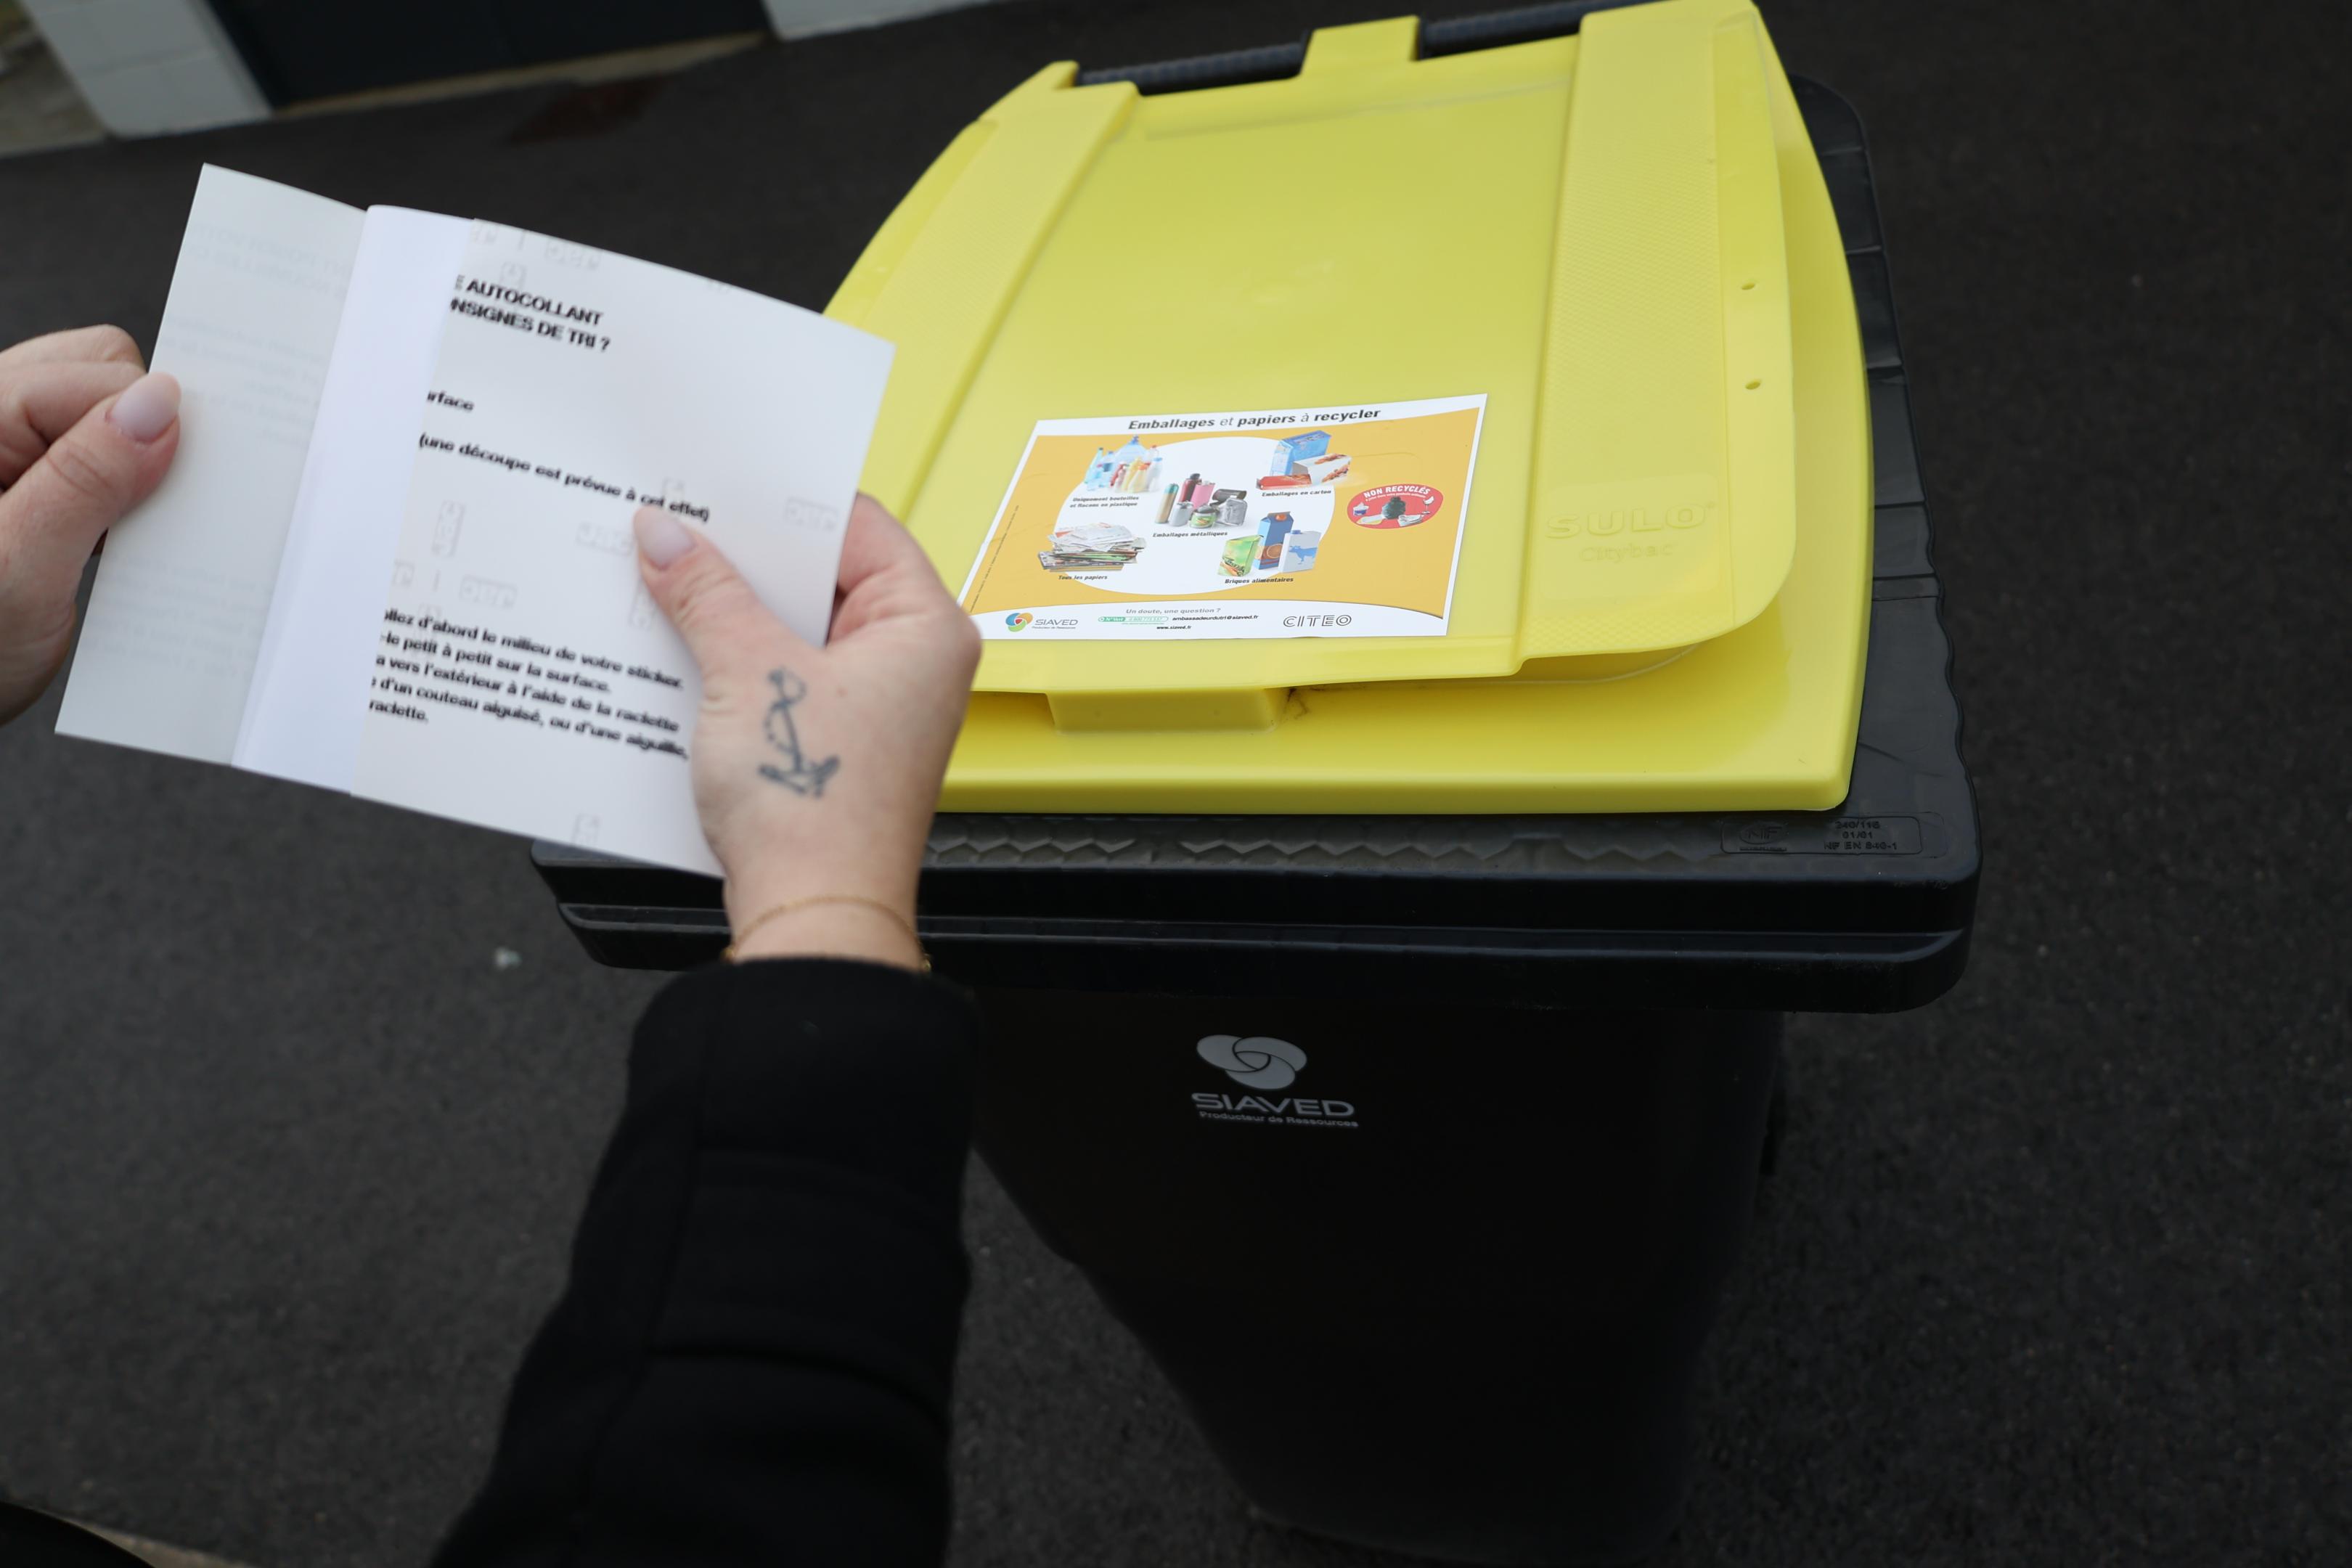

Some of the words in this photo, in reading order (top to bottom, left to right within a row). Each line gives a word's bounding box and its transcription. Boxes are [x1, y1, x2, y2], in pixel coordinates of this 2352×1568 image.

[467, 279, 603, 326] AUTOCOLLANT
[451, 298, 534, 332] NSIGNES
[537, 321, 563, 340] DE
[568, 328, 595, 348] TRI
[601, 337, 611, 351] ?
[1127, 418, 1215, 430] Emballages
[1220, 416, 1234, 427] et
[1236, 415, 1296, 428] papiers
[1300, 412, 1310, 422] à
[1314, 408, 1381, 423] recycler
[419, 432, 455, 452] (une
[459, 442, 531, 471] découpe
[536, 465, 562, 480] est
[564, 474, 621, 497] prévue
[625, 486, 635, 501] à
[669, 500, 710, 524] effet)
[1363, 488, 1383, 498] NON
[1385, 485, 1431, 495] RECYCLÉS
[1545, 503, 1706, 540] SULO
[1283, 614, 1352, 628] CITEO
[385, 607, 415, 626] llez
[417, 615, 479, 640] d'abord
[482, 628, 497, 643] le
[501, 636, 551, 656] milieu
[555, 645, 576, 662] de
[581, 654, 623, 673] votre
[626, 664, 685, 690] sticker.
[402, 637, 438, 656] petit
[441, 642, 453, 658] à
[455, 648, 494, 667] petit
[496, 657, 524, 673] sur
[527, 661, 542, 678] la
[546, 669, 611, 694] surface.
[369, 698, 430, 724] raclette.
[389, 656, 421, 675] vers
[423, 661, 504, 693] l'extérieur
[506, 680, 518, 697] à
[521, 684, 568, 706] l'aide
[571, 695, 592, 712] de
[596, 700, 612, 717] la
[616, 709, 681, 735] raclette
[380, 676, 413, 697] d'un
[415, 686, 479, 711] couteau
[482, 699, 544, 727] aiguisé,
[550, 715, 571, 732] ou
[574, 719, 622, 742] d'une
[626, 732, 690, 762] aiguille,
[1824, 841, 1840, 850] NF
[1845, 841, 1862, 850] EN
[1191, 1092, 1355, 1118] SIAVED
[1199, 1110, 1266, 1123] Producteur
[1268, 1114, 1283, 1124] de
[1286, 1116, 1359, 1128] Ressources
